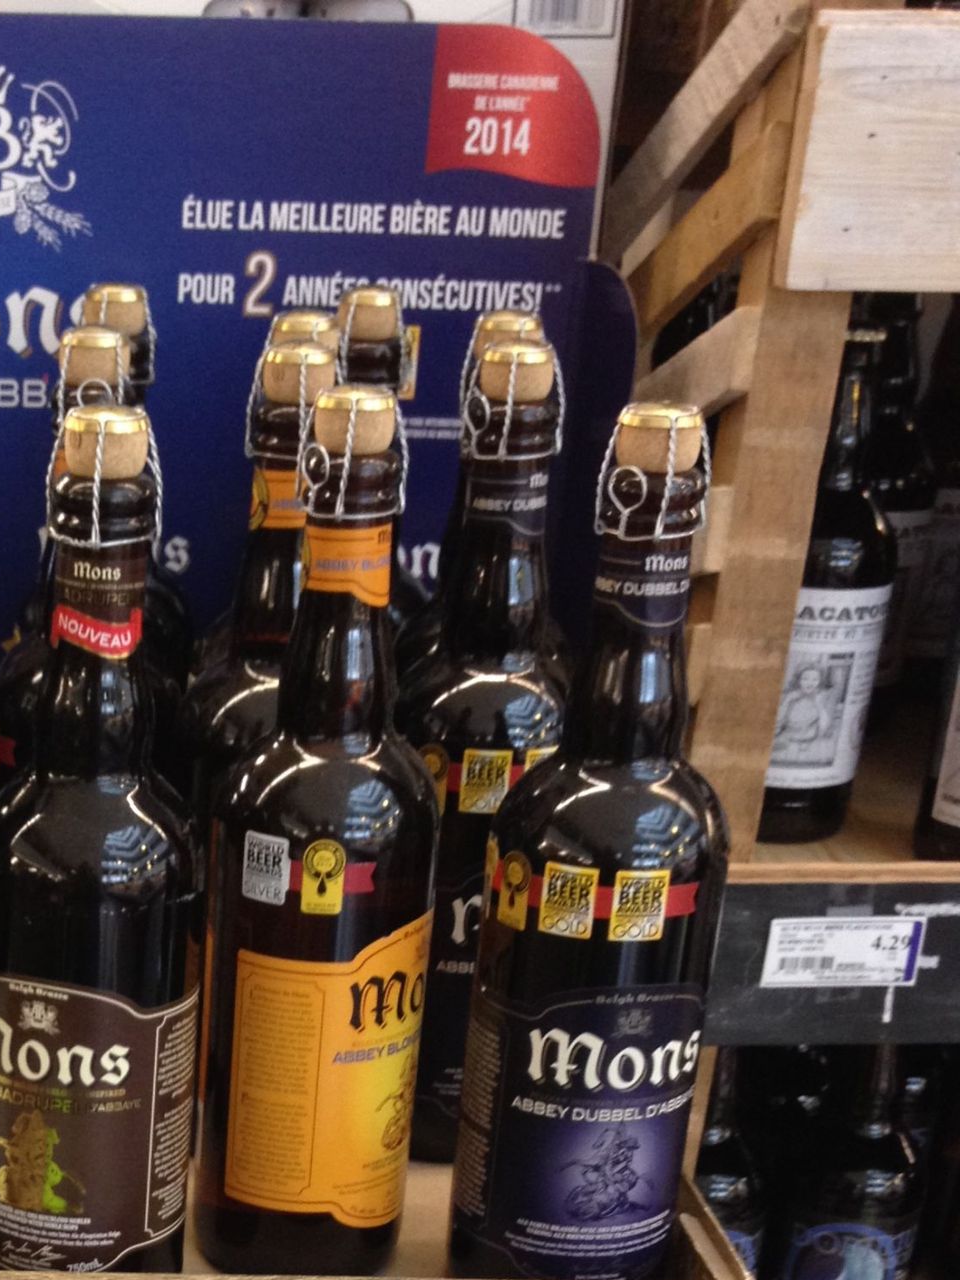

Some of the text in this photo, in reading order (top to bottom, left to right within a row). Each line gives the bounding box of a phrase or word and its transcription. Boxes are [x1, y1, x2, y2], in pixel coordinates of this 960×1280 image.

[463, 117, 531, 156] 2014
[182, 194, 566, 240] ÉLUE LA MEILLEURE BIÈRE AU MONDE
[177, 273, 234, 305] POUR
[243, 250, 277, 318] 2
[74, 560, 121, 580] Mons
[645, 554, 688, 572] Mons
[58, 613, 132, 647] NOUVEAU
[466, 765, 507, 782] BEER
[247, 848, 283, 868] BEER
[244, 880, 282, 899] SILVER
[546, 880, 593, 901] BEER
[619, 887, 661, 904] BEER
[543, 914, 590, 936] GOLD
[613, 919, 659, 938] GOLD
[332, 1043, 386, 1066] ABBEY
[528, 1026, 699, 1093] Mons
[511, 1095, 643, 1122] ABBEY DUBBEL
